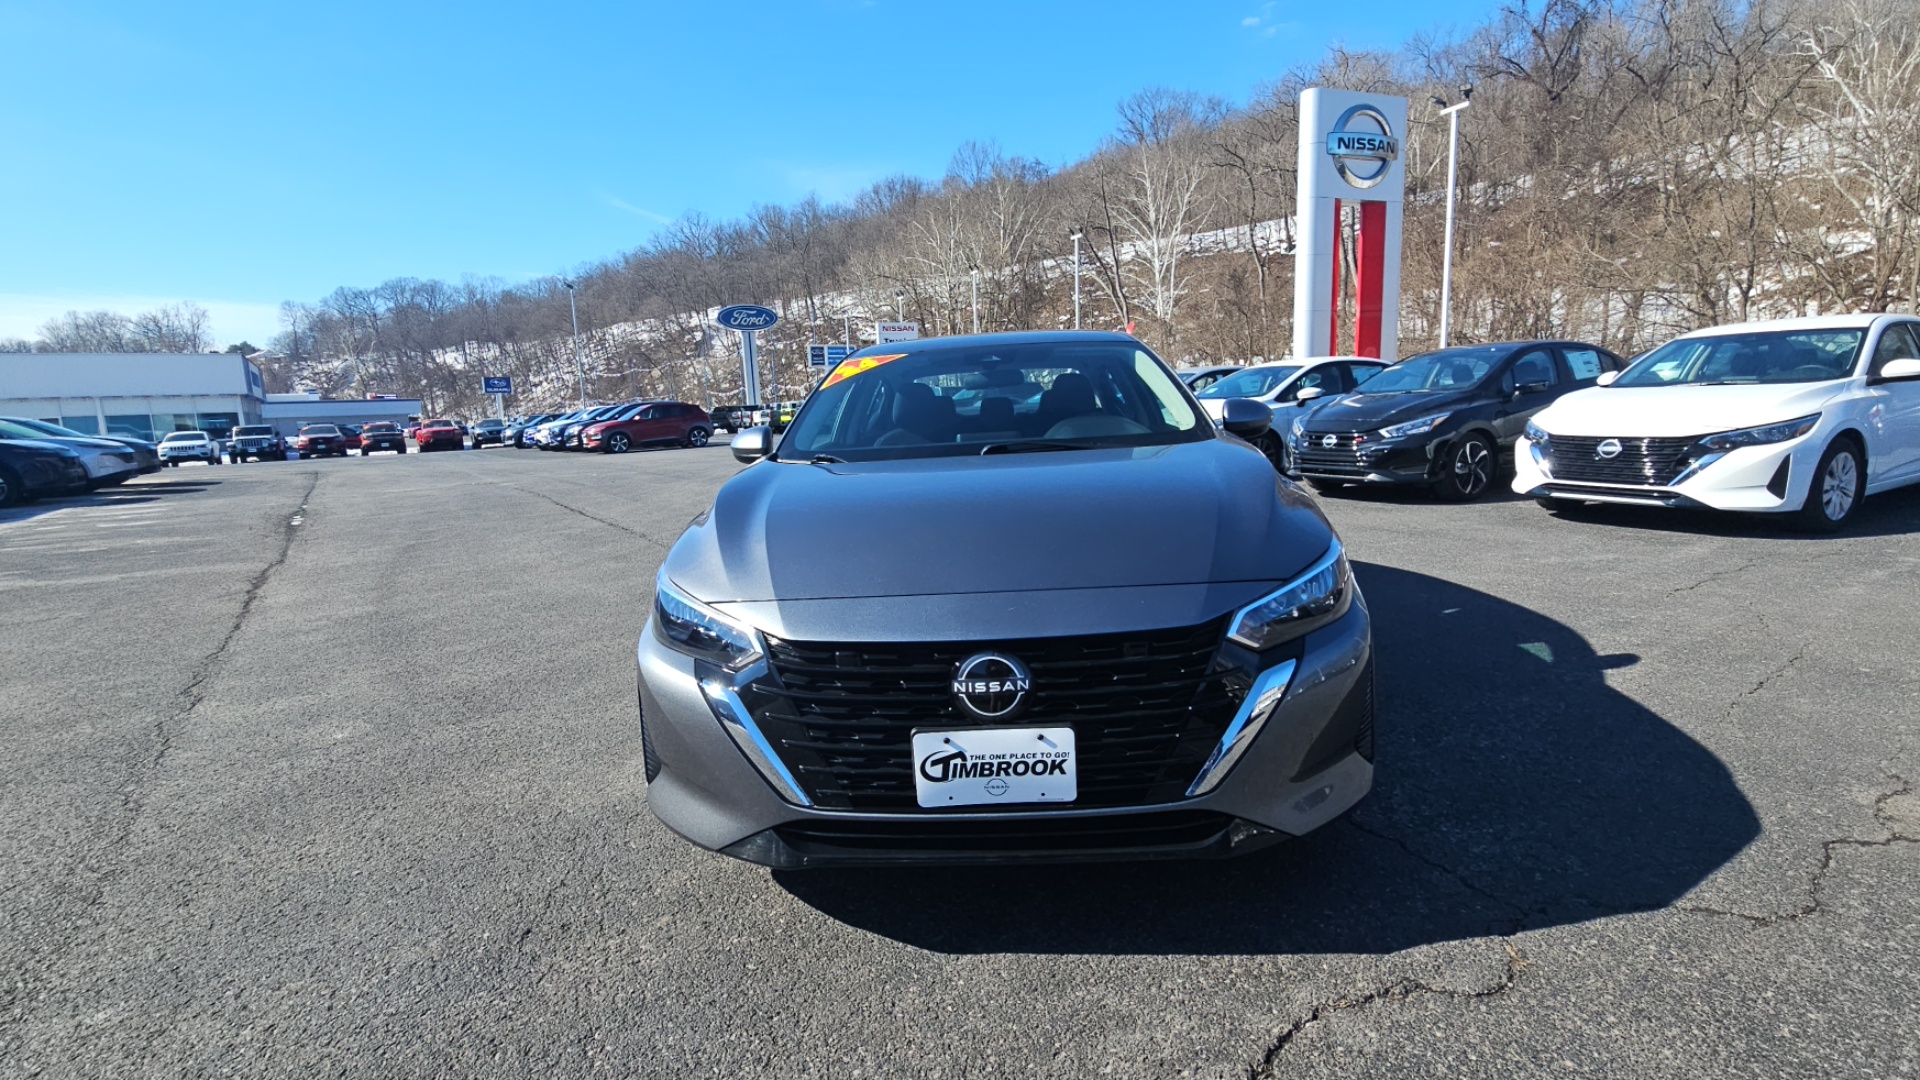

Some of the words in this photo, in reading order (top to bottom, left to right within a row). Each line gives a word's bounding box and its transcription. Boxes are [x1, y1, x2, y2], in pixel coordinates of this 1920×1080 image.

[1337, 136, 1395, 154] NISSAN
[730, 309, 766, 326] Ford
[953, 679, 1029, 693] NISSAN
[1009, 752, 1037, 760] PLACE
[1054, 751, 1070, 759] GO!
[920, 750, 1068, 783] TIMBROOK
